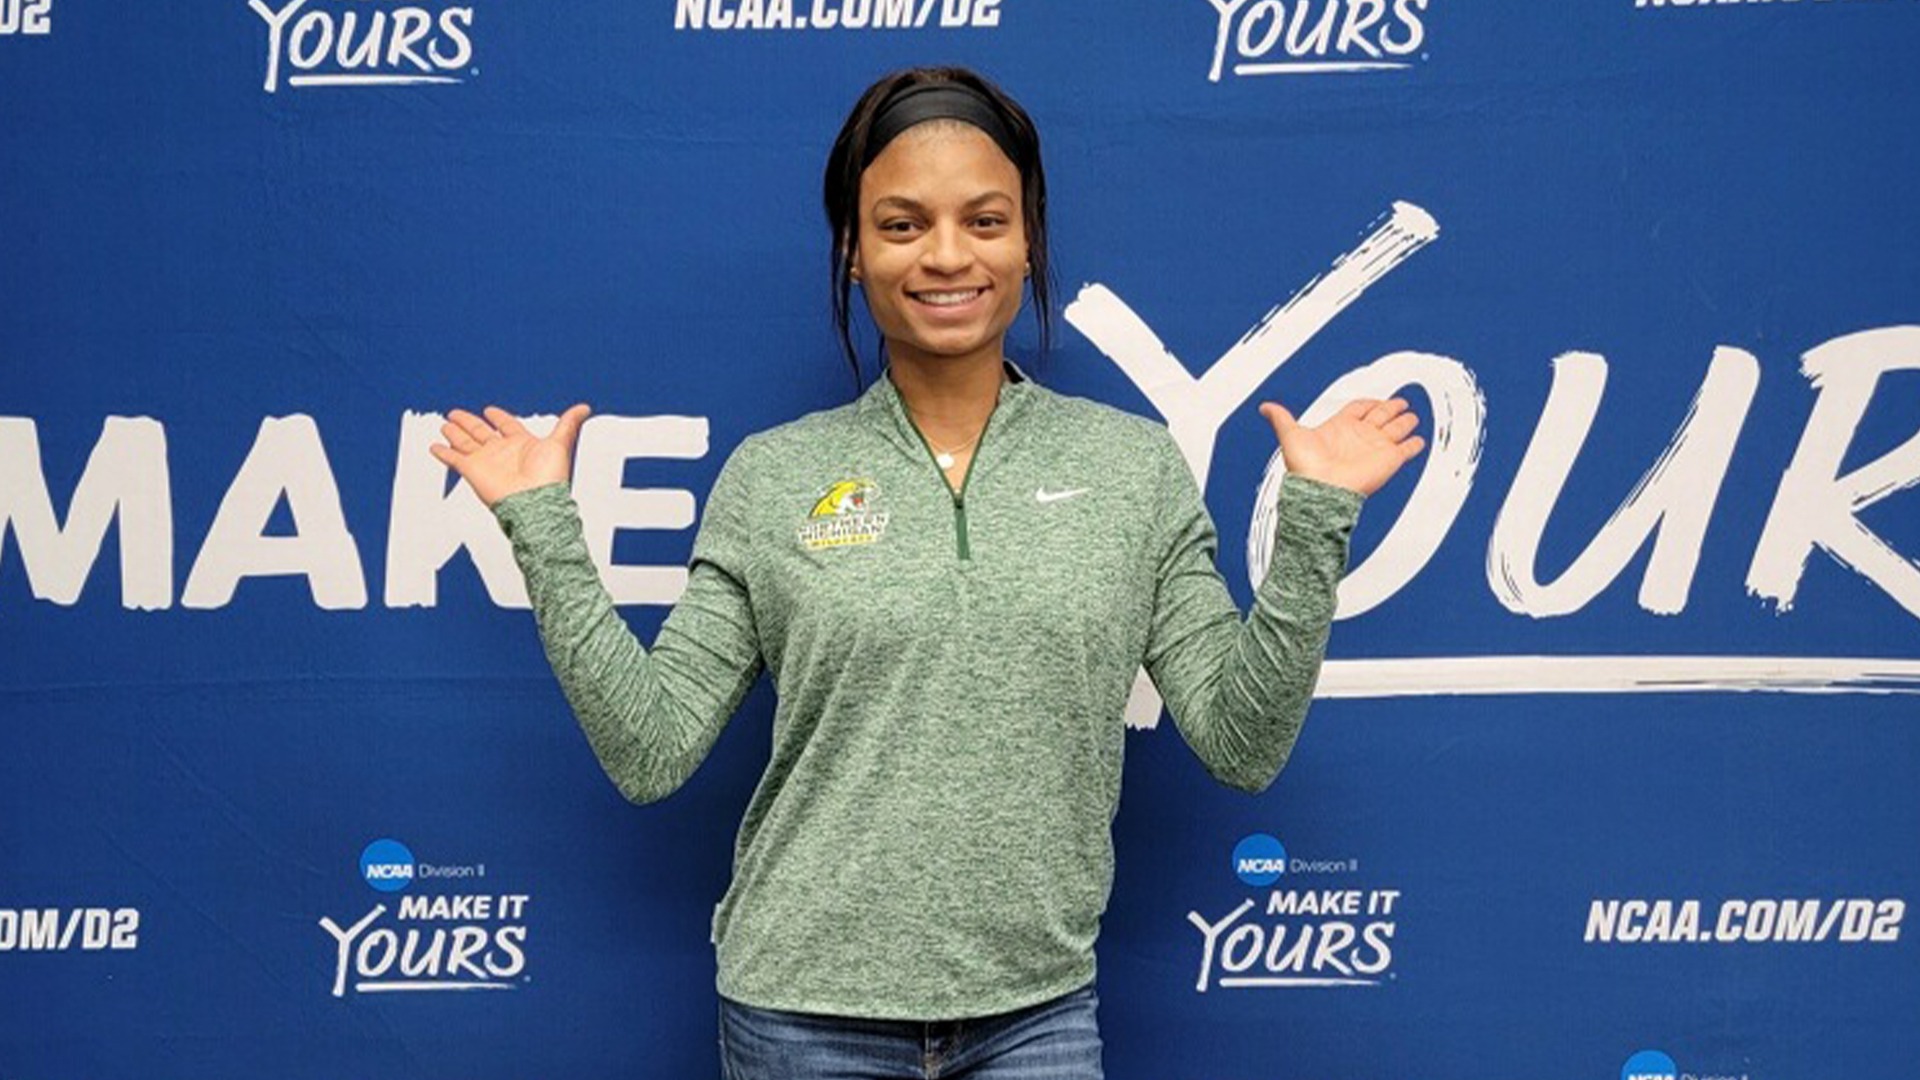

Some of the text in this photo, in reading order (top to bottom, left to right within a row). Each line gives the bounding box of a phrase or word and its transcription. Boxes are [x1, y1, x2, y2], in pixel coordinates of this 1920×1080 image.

[674, 0, 1001, 29] NCAA.COM/D2
[248, 0, 473, 92] YOURS
[1208, 0, 1428, 82] YOURS
[366, 864, 414, 879] NCAA
[418, 864, 474, 877] Division
[1237, 858, 1285, 873] NCAA
[1290, 859, 1346, 872] Division
[398, 895, 529, 920] MAKE IT
[1266, 890, 1400, 915] MAKE IT
[1583, 899, 1906, 942] NCAA.COM/D2
[318, 903, 527, 997] YOURS
[1187, 898, 1396, 992] YOURS
